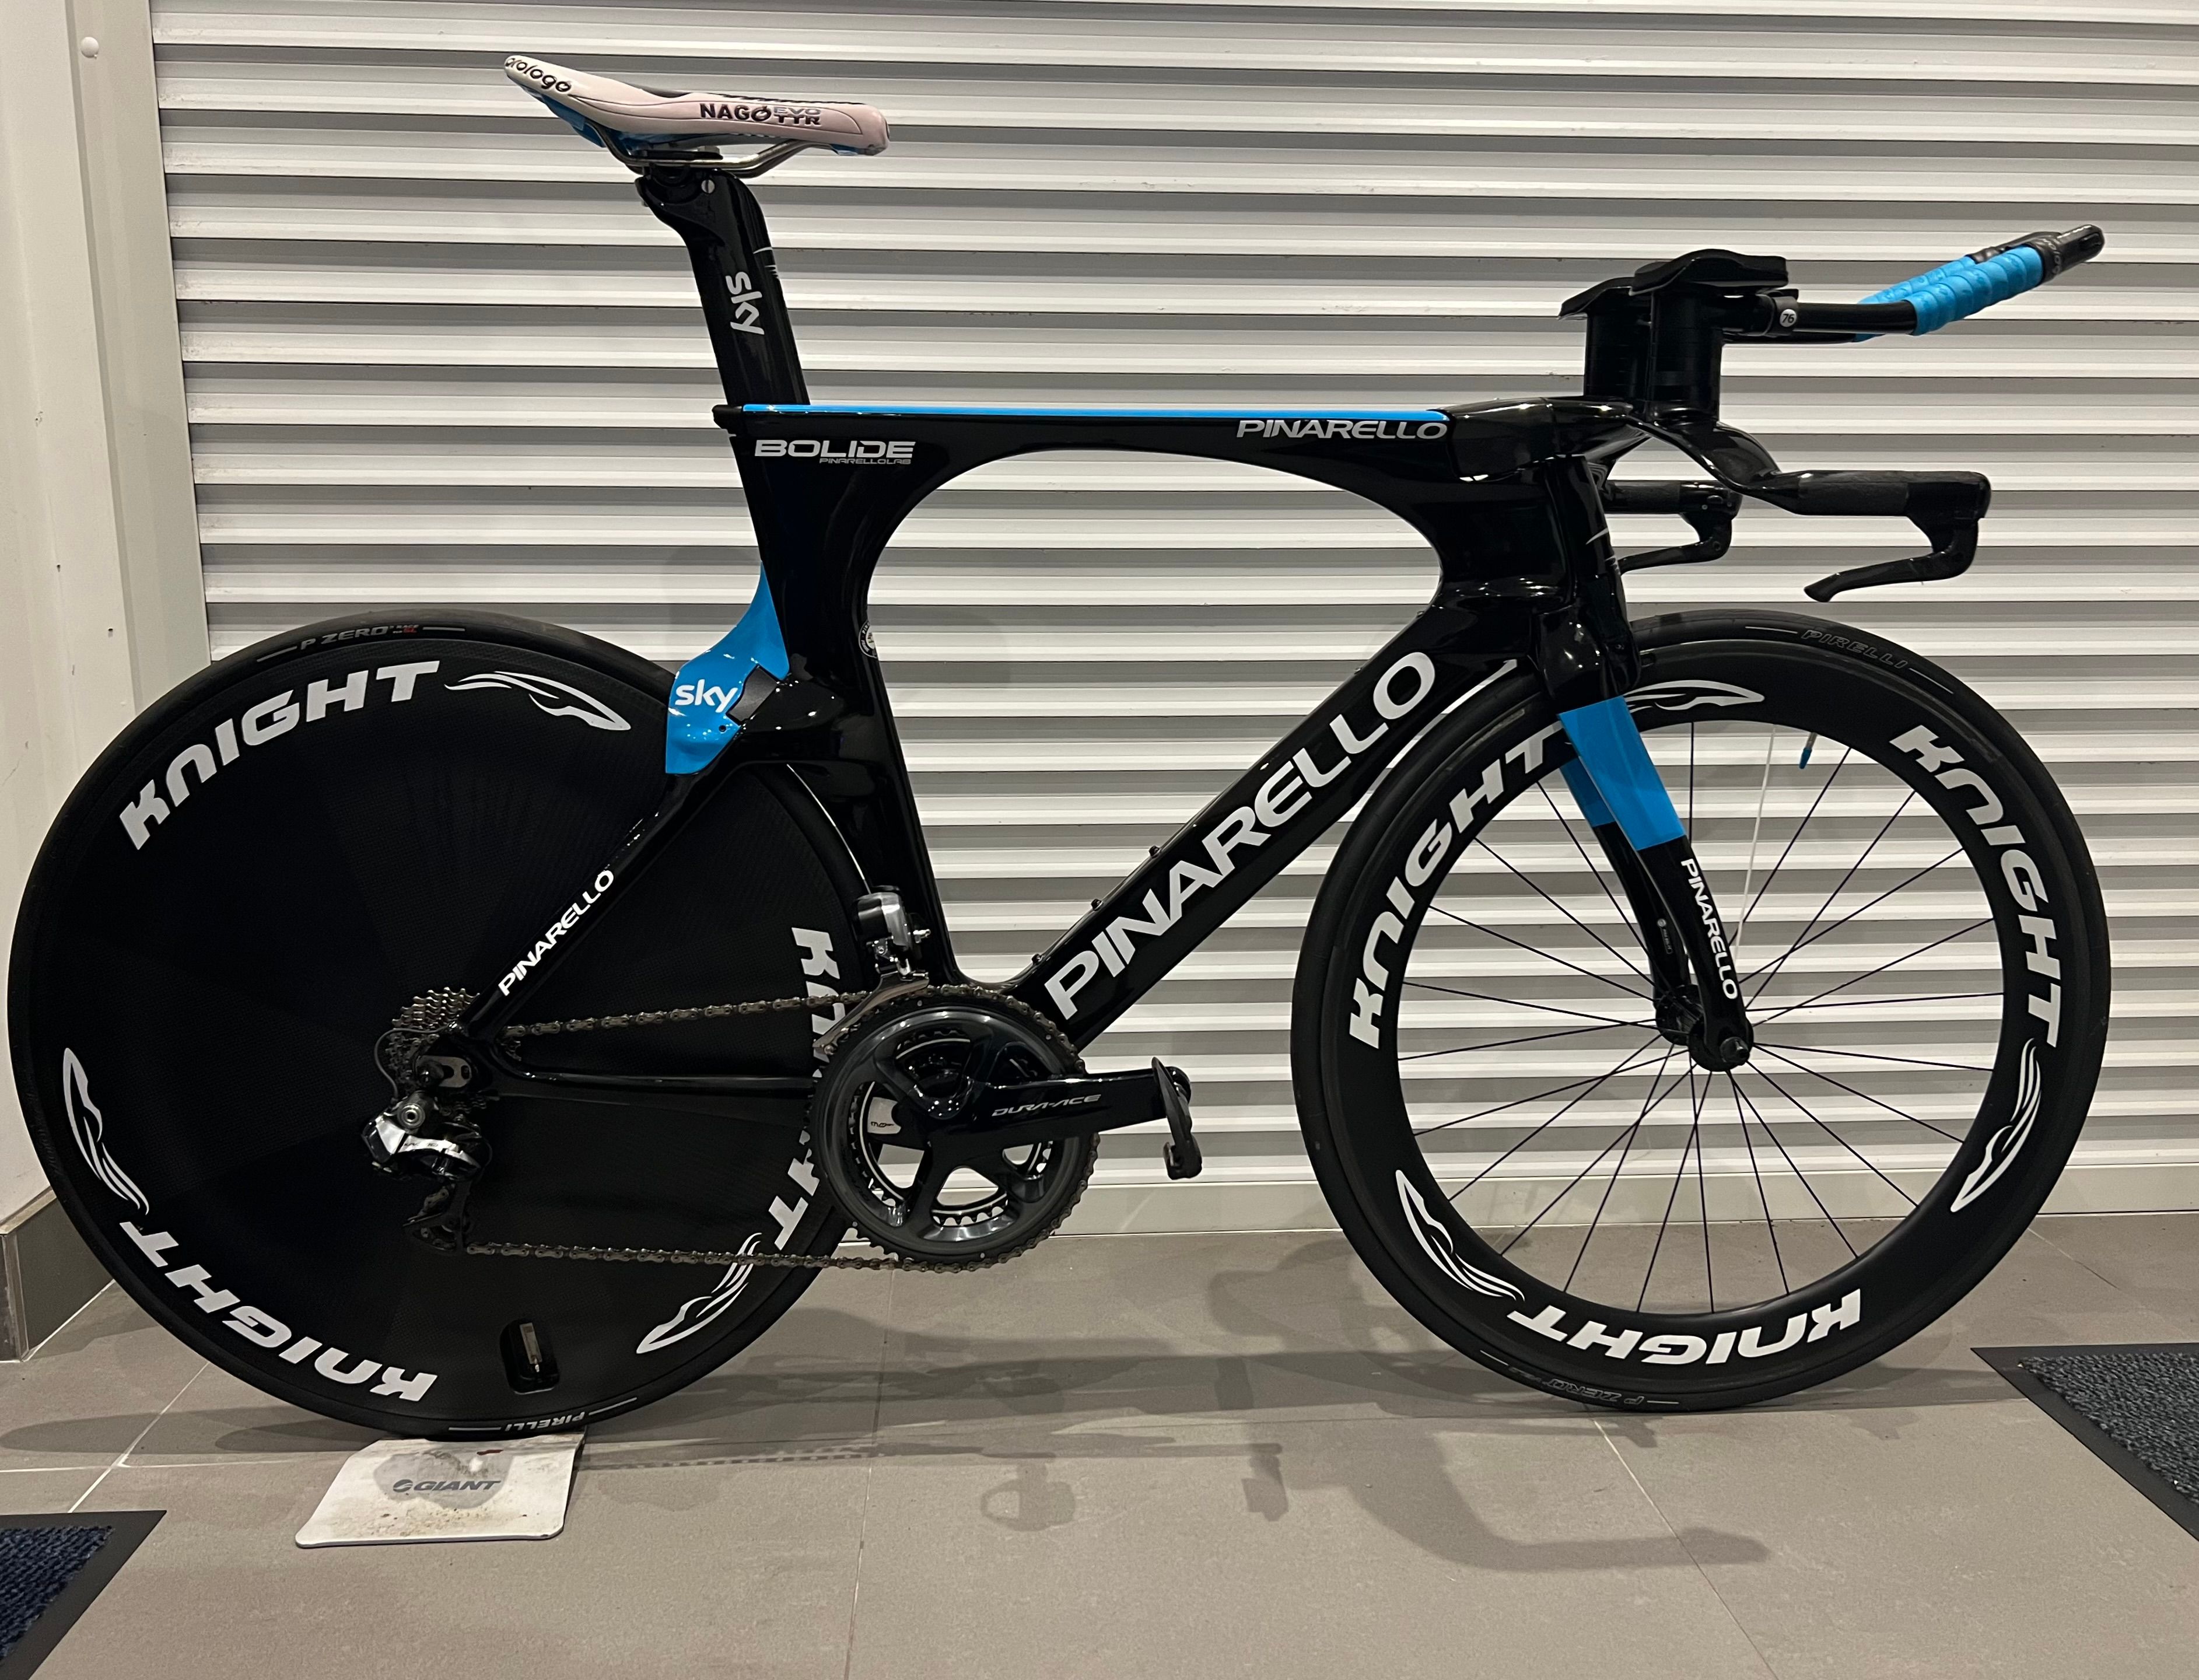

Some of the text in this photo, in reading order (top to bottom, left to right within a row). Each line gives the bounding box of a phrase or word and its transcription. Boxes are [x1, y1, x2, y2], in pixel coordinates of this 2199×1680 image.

[1782, 313, 1795, 323] 76
[1236, 419, 1448, 439] PINARELLO
[754, 439, 916, 459] BOLIDE
[300, 638, 316, 650] P
[321, 626, 388, 645] ZERO
[1801, 630, 1908, 668] PIRELLI
[675, 679, 738, 713] sky
[119, 660, 440, 850] KNIGHT
[1044, 652, 1436, 1020] PINARELLO
[1349, 720, 1567, 1049] KNIGHT
[1889, 724, 2062, 1048] KNIGHT
[498, 870, 614, 996] PINARELLO
[1681, 858, 1738, 999] PINARELLO
[992, 1094, 1102, 1116] DURA-ACE
[120, 1221, 438, 1402] KNIGHT
[1507, 1288, 1861, 1365] KNIGHT
[1547, 1378, 1622, 1402] ZERO
[505, 1412, 585, 1432] PIRELLI
[414, 1480, 502, 1492] GIANT
